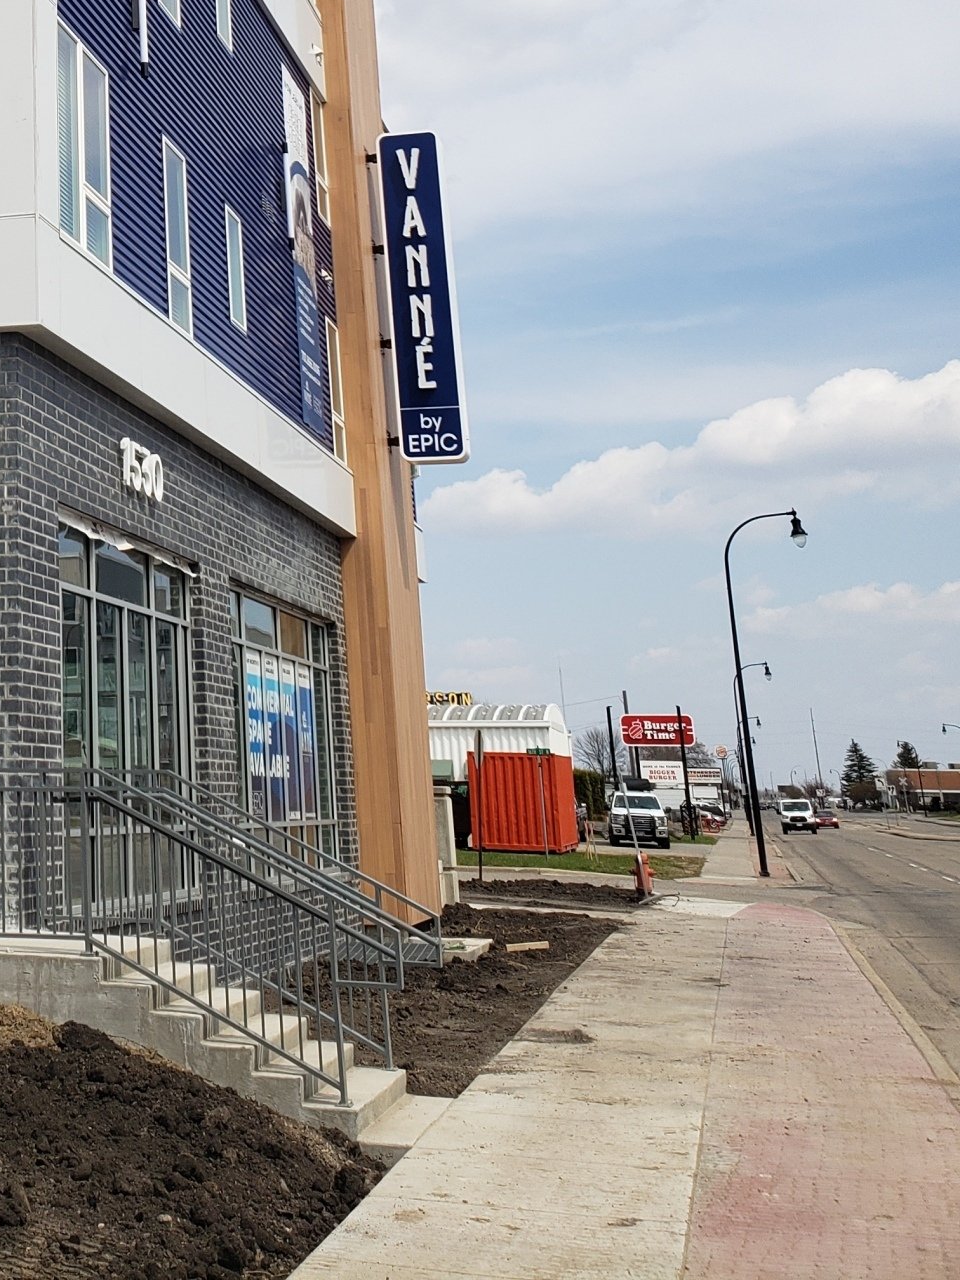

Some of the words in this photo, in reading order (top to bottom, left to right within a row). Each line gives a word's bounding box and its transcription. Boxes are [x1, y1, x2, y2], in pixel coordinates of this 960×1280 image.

[395, 147, 437, 390] VANNÉ
[420, 413, 442, 433] by
[408, 432, 458, 453] EPIC
[248, 718, 272, 745] SPAE
[643, 721, 686, 732] Burger
[644, 731, 676, 740] Time
